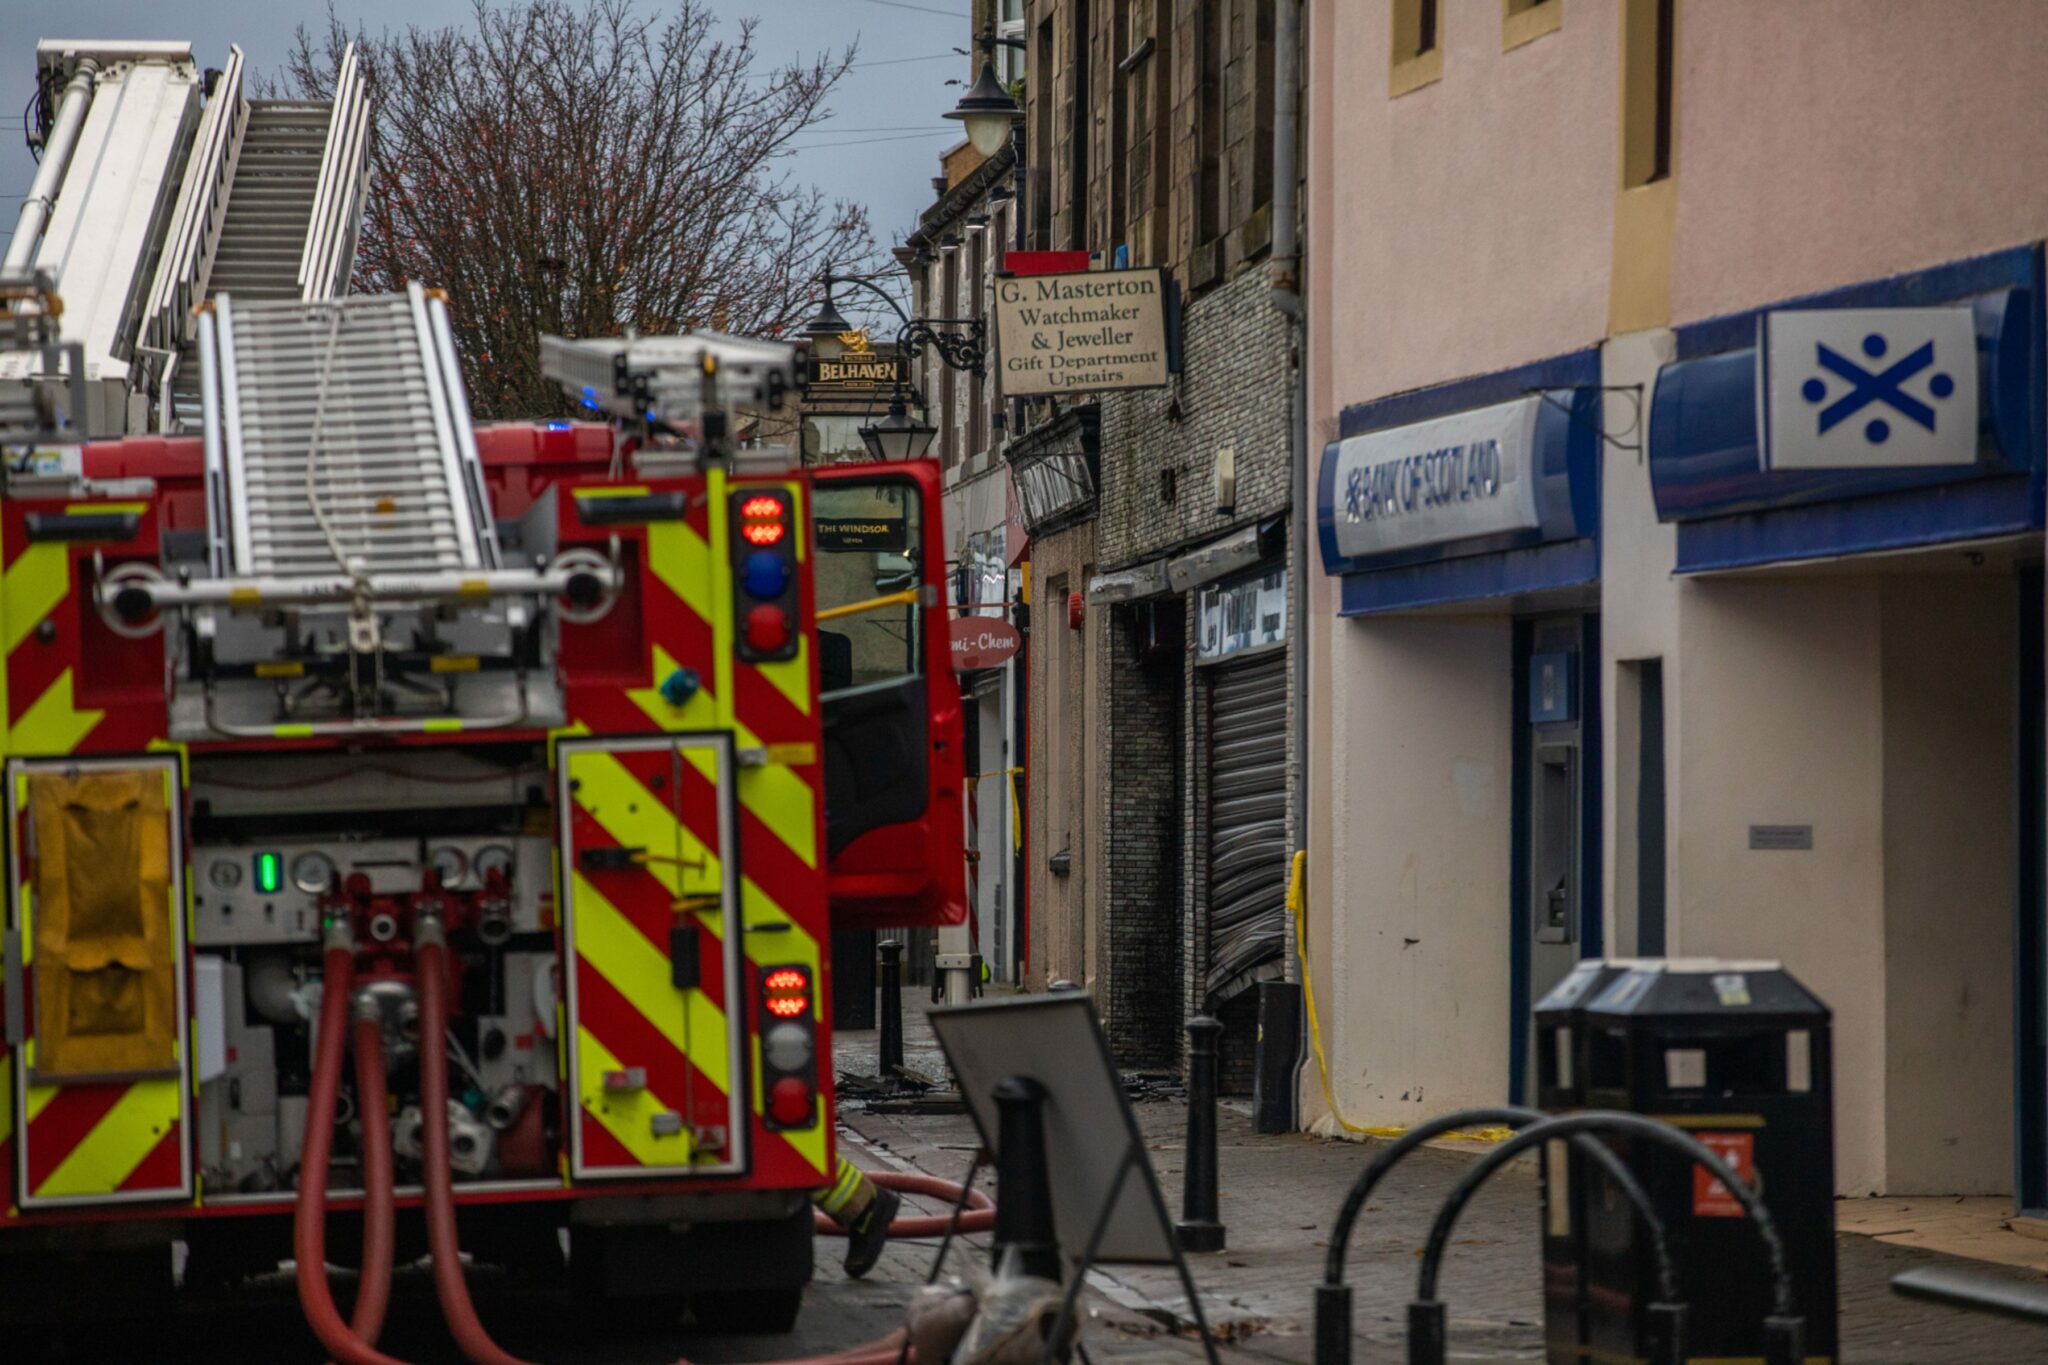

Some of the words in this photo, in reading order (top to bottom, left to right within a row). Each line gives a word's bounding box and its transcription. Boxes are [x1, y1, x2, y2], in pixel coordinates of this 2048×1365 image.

[1001, 282, 1027, 303] G.
[1037, 278, 1156, 300] Masterton
[1019, 304, 1140, 326] Watchmaker
[1031, 331, 1051, 349] &
[1057, 327, 1133, 351] Jeweller
[1008, 355, 1044, 371] Gift
[1050, 351, 1158, 369] Department
[819, 362, 898, 381] BELHAVEN
[1049, 370, 1124, 387] Upstairs
[818, 525, 837, 533] THE
[839, 524, 890, 533] WINDSOR
[950, 632, 1014, 651] mi-Chem
